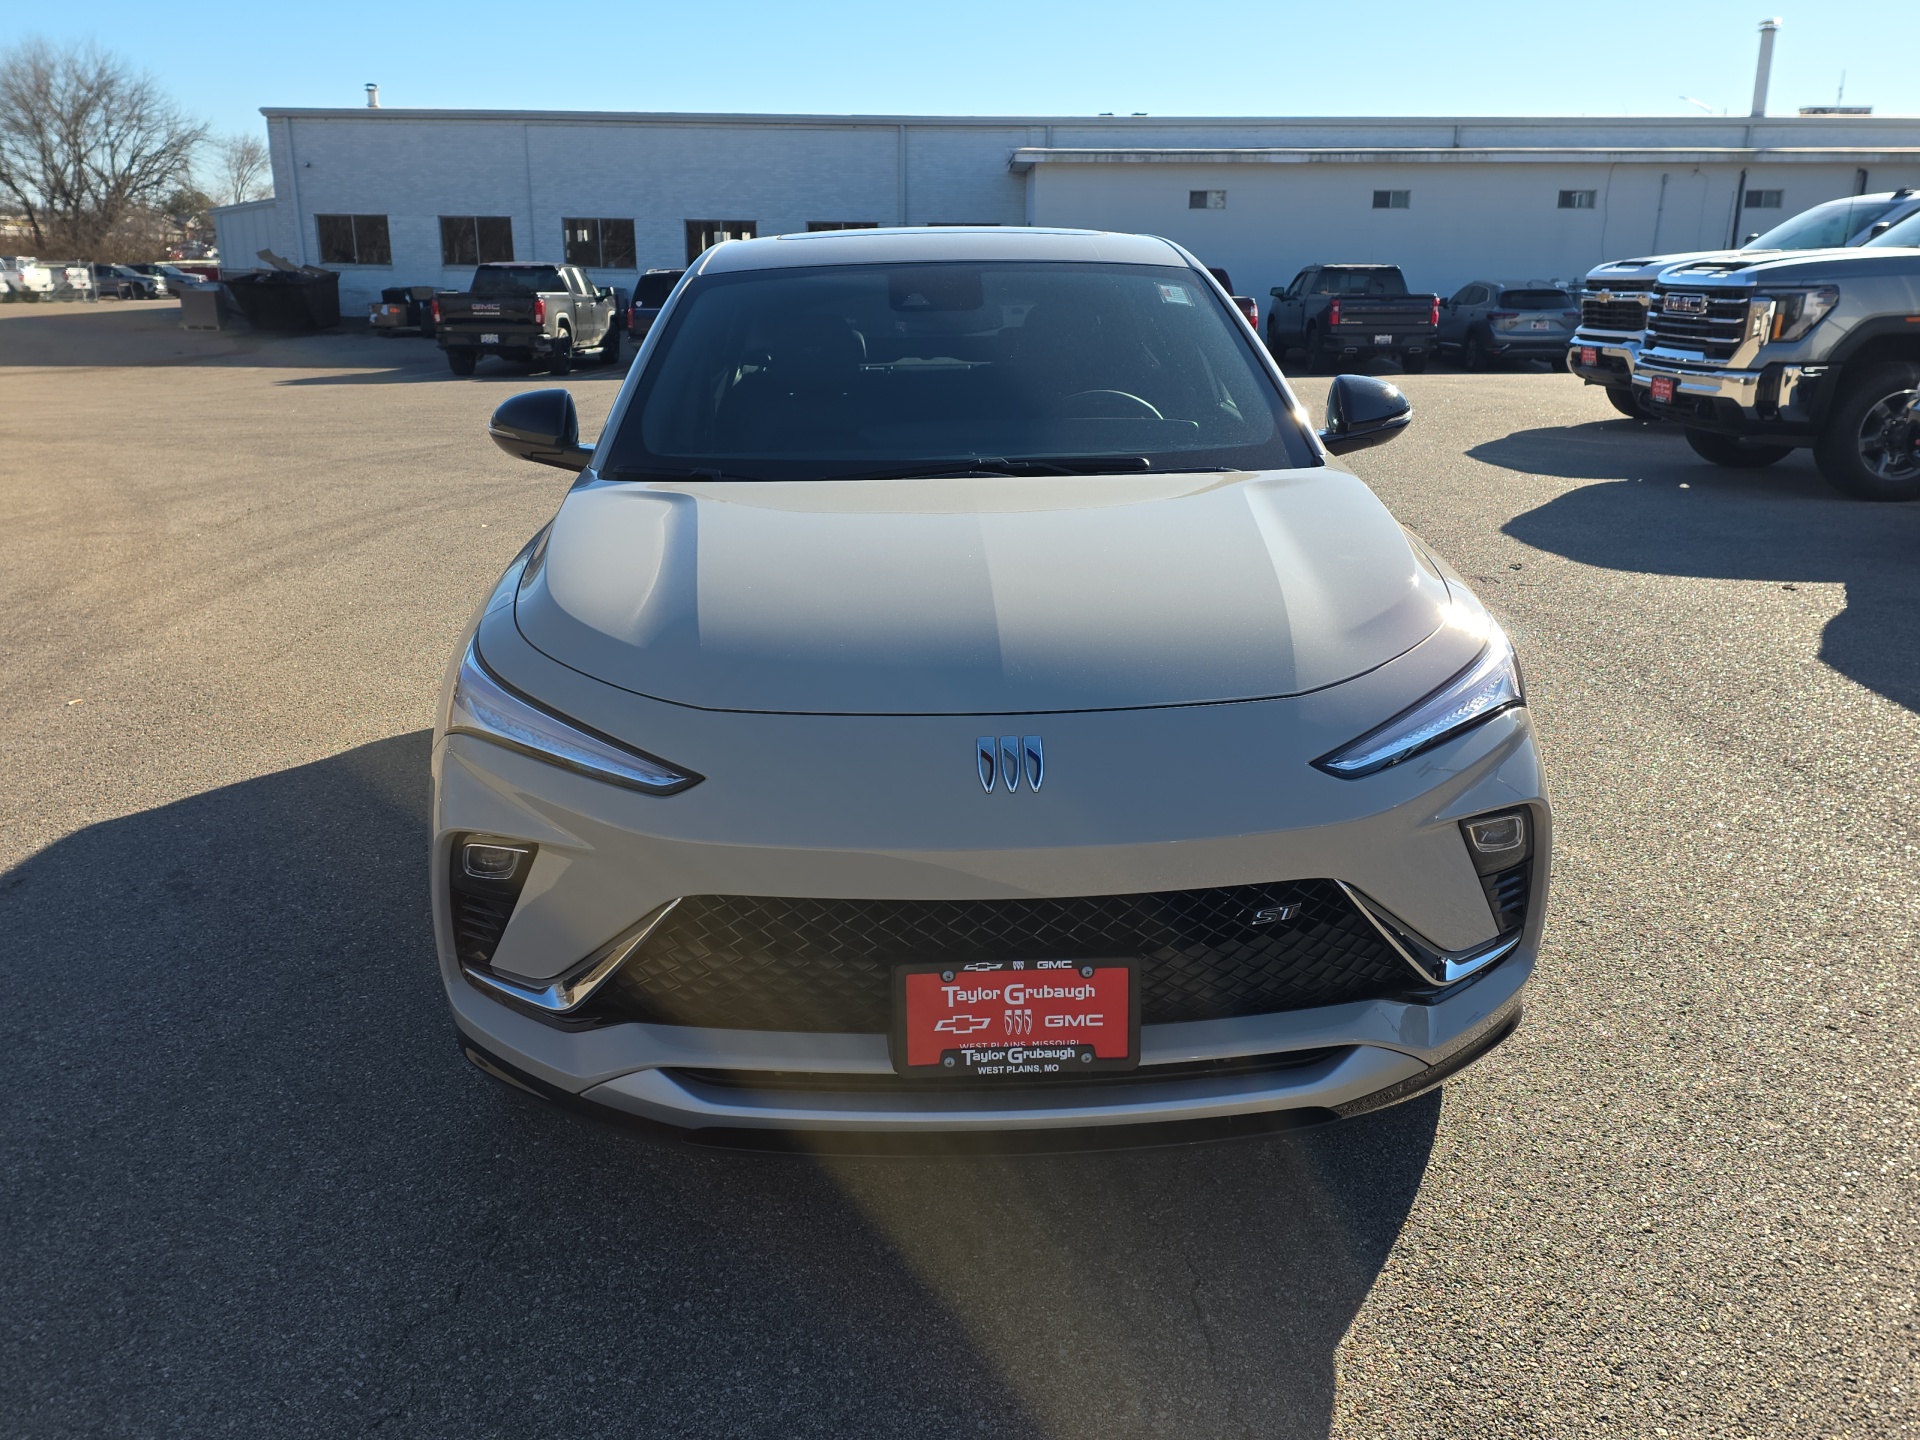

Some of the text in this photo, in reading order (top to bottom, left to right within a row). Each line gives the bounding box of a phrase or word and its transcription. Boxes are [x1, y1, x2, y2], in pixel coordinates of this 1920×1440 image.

[1251, 902, 1302, 925] ST
[1036, 960, 1072, 969] GMC
[940, 983, 1095, 1008] Taylor Grubaugh
[1045, 1014, 1104, 1028] GMC
[961, 1047, 1076, 1066] Taylor Grubaugh
[977, 1064, 1060, 1075] WEST PLAINS, MO
